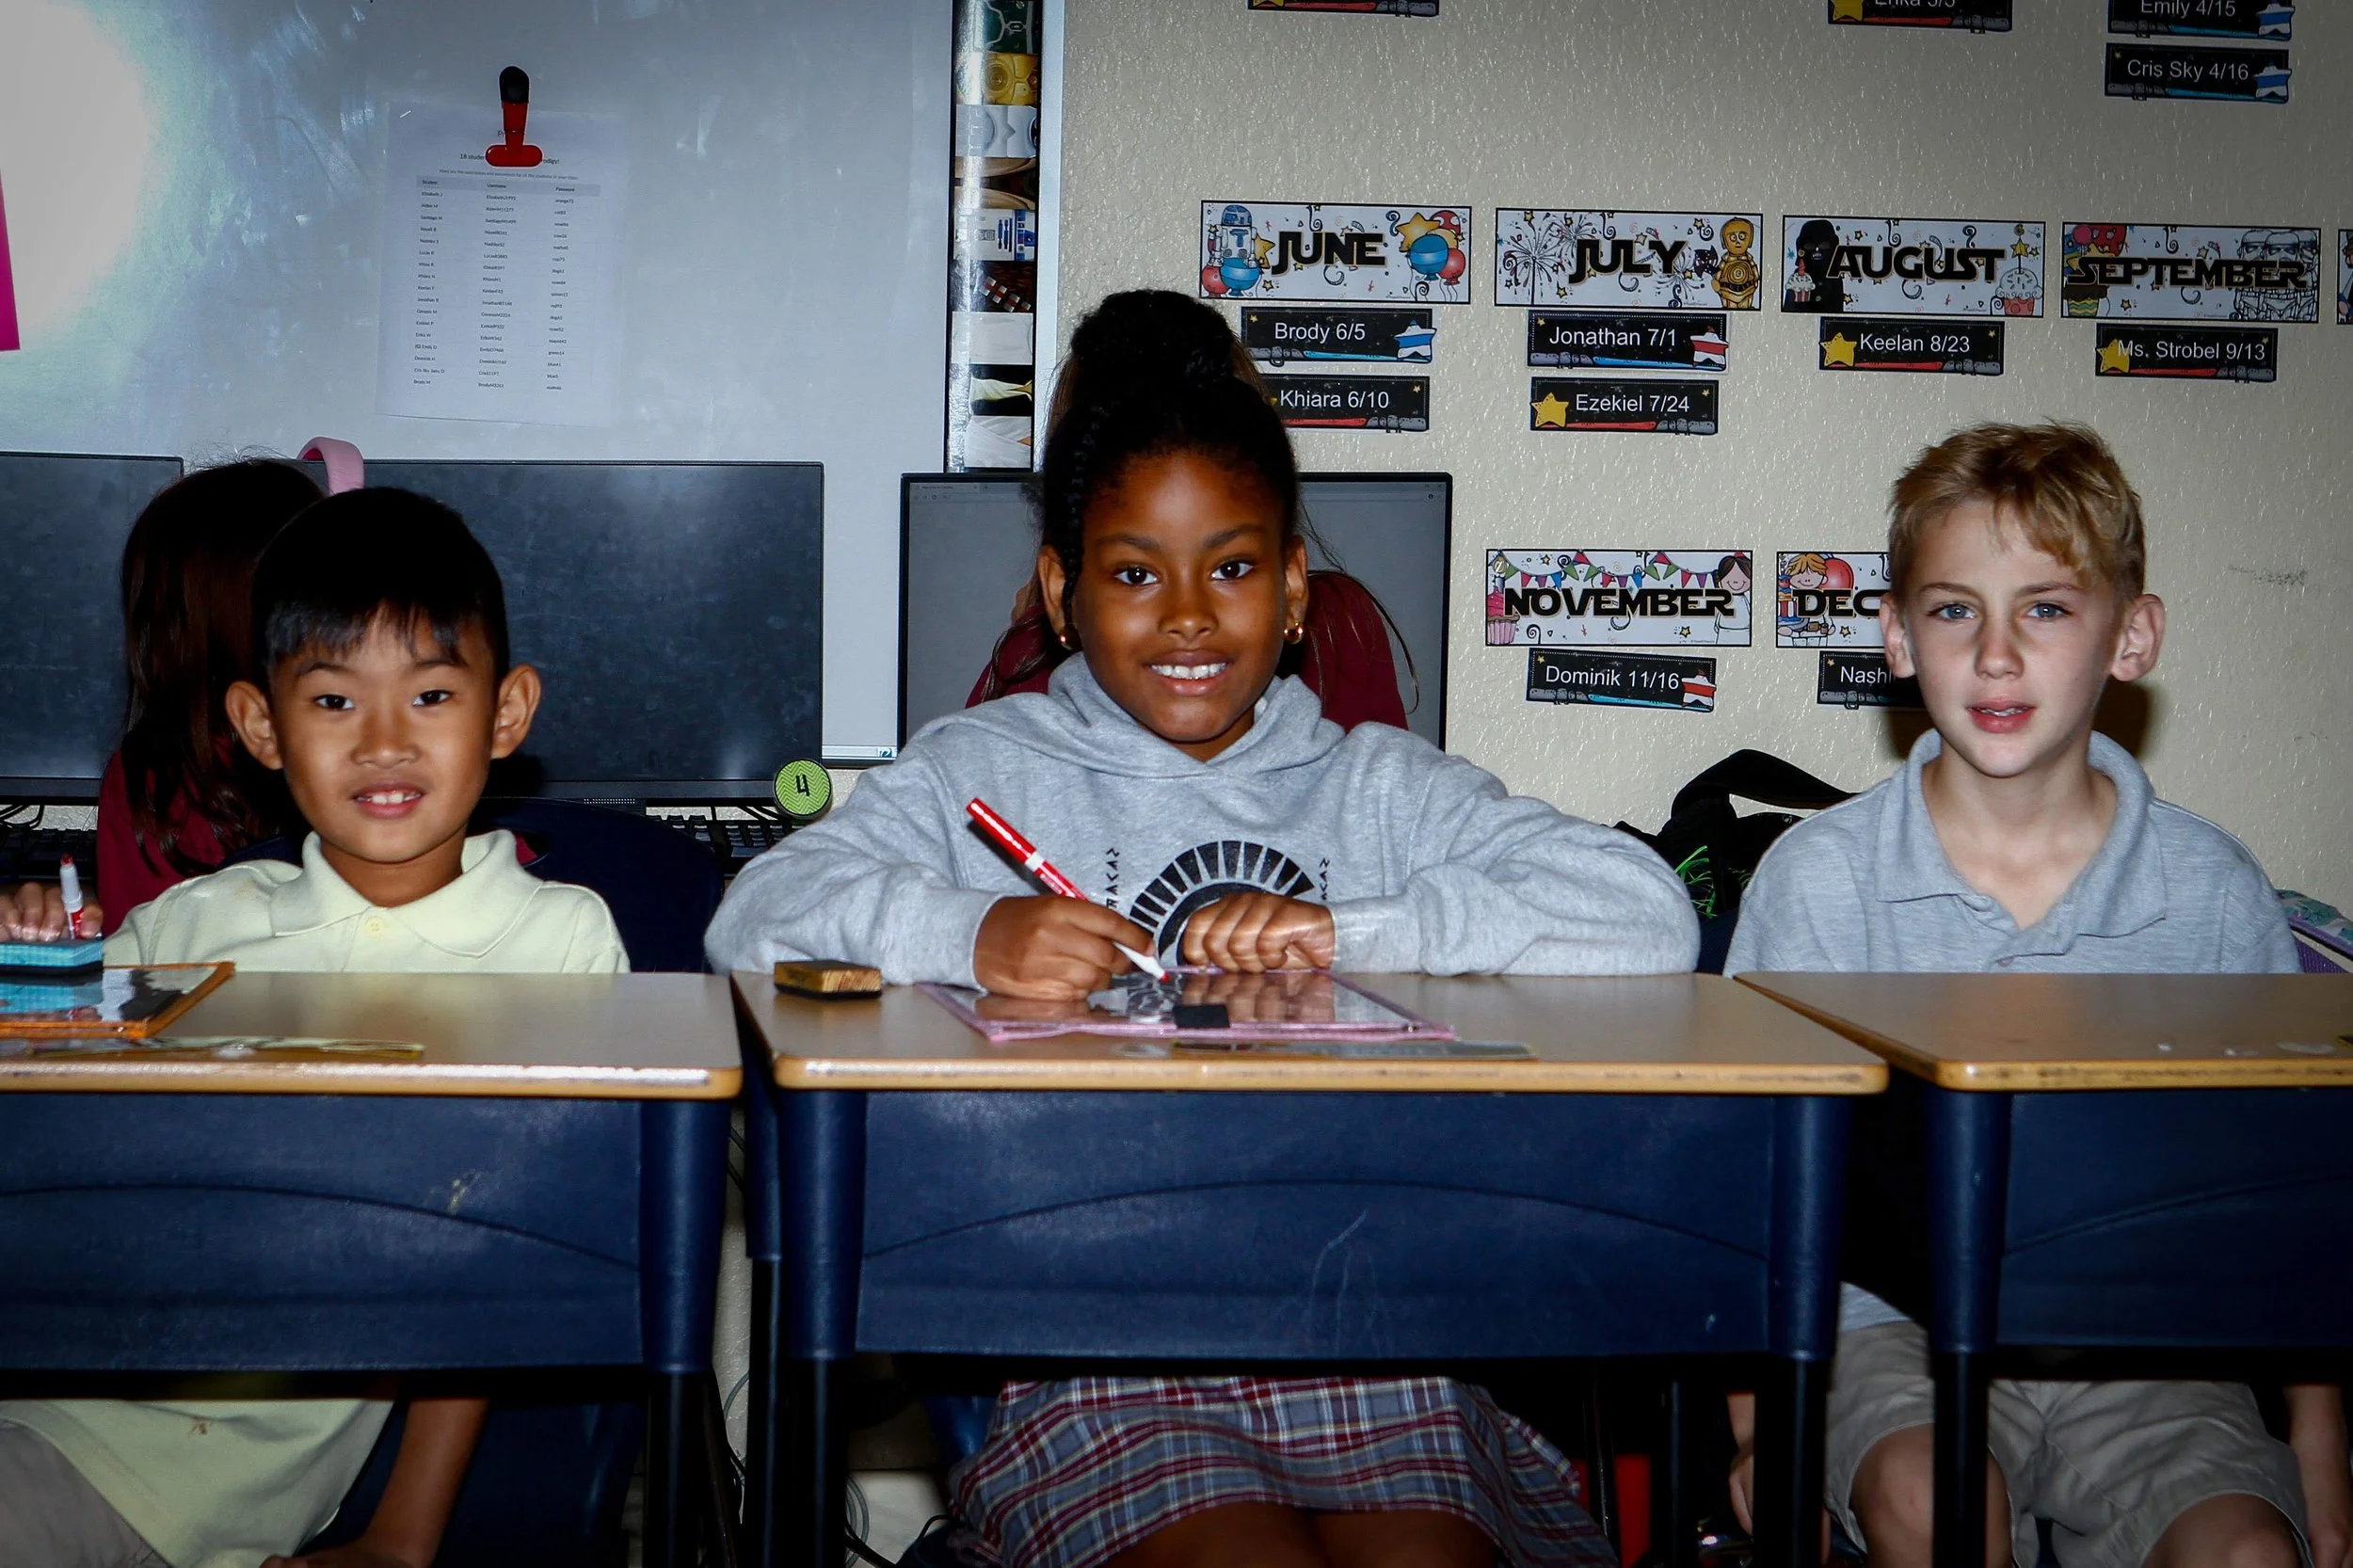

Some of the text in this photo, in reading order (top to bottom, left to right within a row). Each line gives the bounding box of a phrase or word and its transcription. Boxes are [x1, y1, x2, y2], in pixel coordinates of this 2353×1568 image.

[2141, 0, 2236, 18] Emily 4/15
[2127, 59, 2249, 83] Cris Sky 4/16
[1272, 231, 1387, 275] JUNE
[1568, 239, 1689, 286] JULY
[1826, 246, 2007, 283] AUGUST
[2066, 257, 2309, 289] SEPTEMBER
[1274, 322, 1366, 344] Brody 6/5
[1549, 326, 1675, 346] Jonathan 7/1
[1860, 333, 1970, 353] Keelan 8/23
[2118, 339, 2266, 361] Ms. Strobel 9/13
[1279, 390, 1389, 408] Khiara 6/10
[1576, 393, 1690, 412] Ezekiel 7/24
[1504, 587, 1737, 618] NOVEMBER
[1545, 665, 1679, 690] Dominik 11/16
[795, 774, 810, 797] 4
